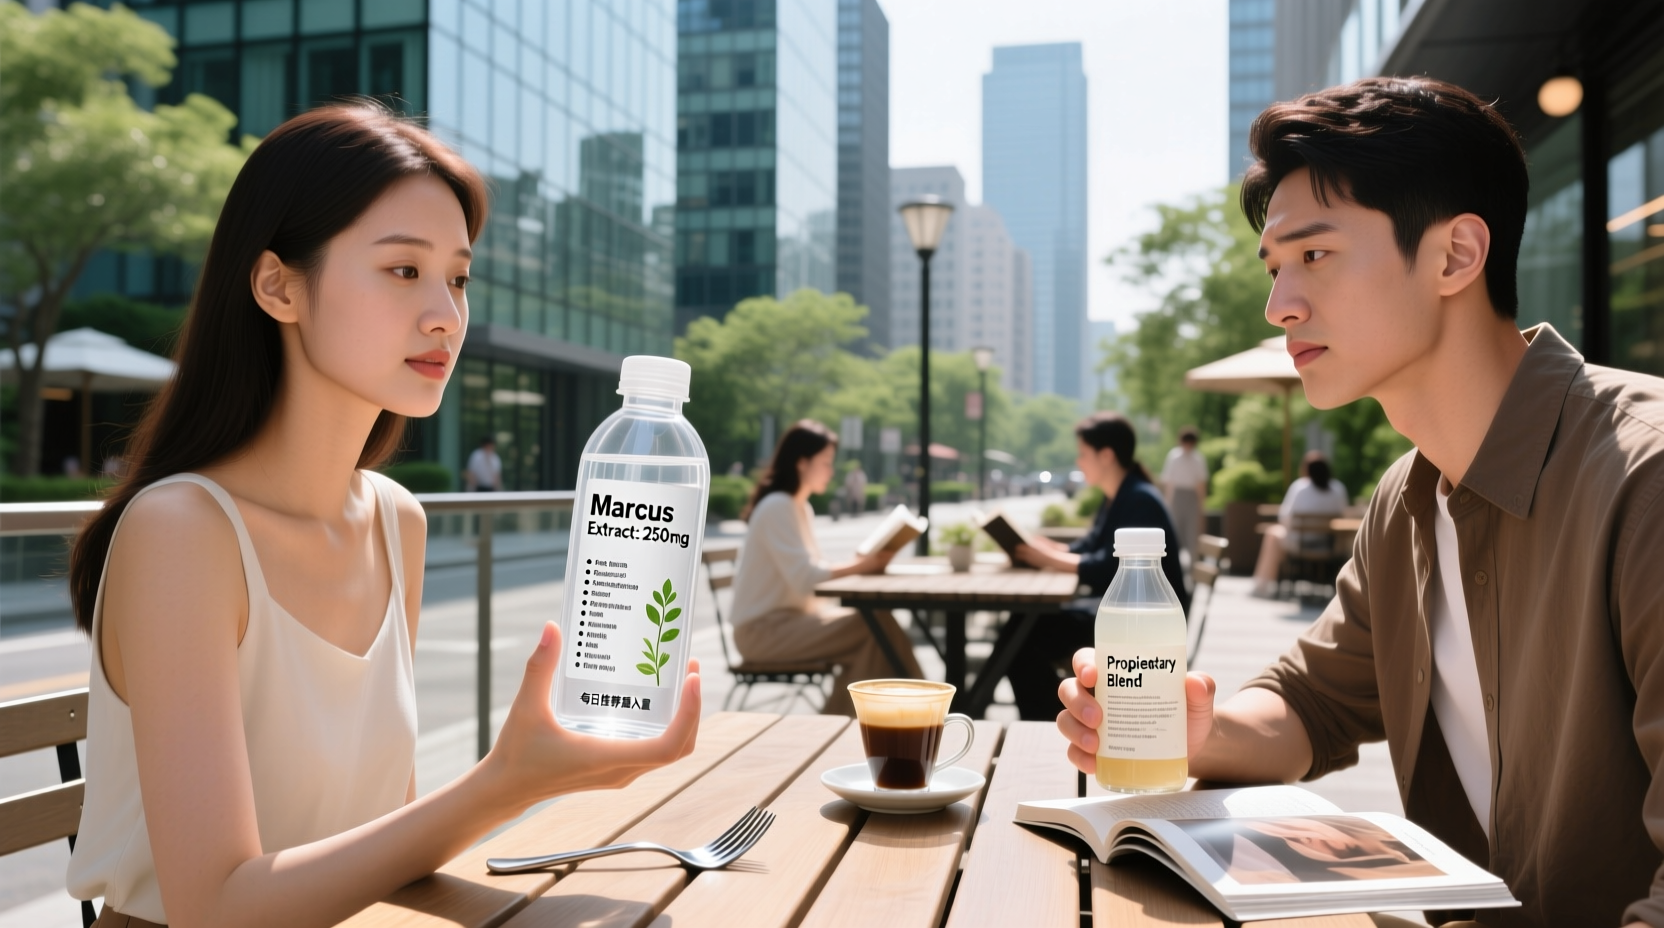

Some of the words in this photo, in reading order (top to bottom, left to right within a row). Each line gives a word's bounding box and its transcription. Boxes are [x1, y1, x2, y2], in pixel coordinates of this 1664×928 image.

[590, 493, 674, 523] Marcus
[587, 521, 640, 540] Extract:
[642, 526, 690, 549] 250mg
[1107, 673, 1143, 688] Blend
